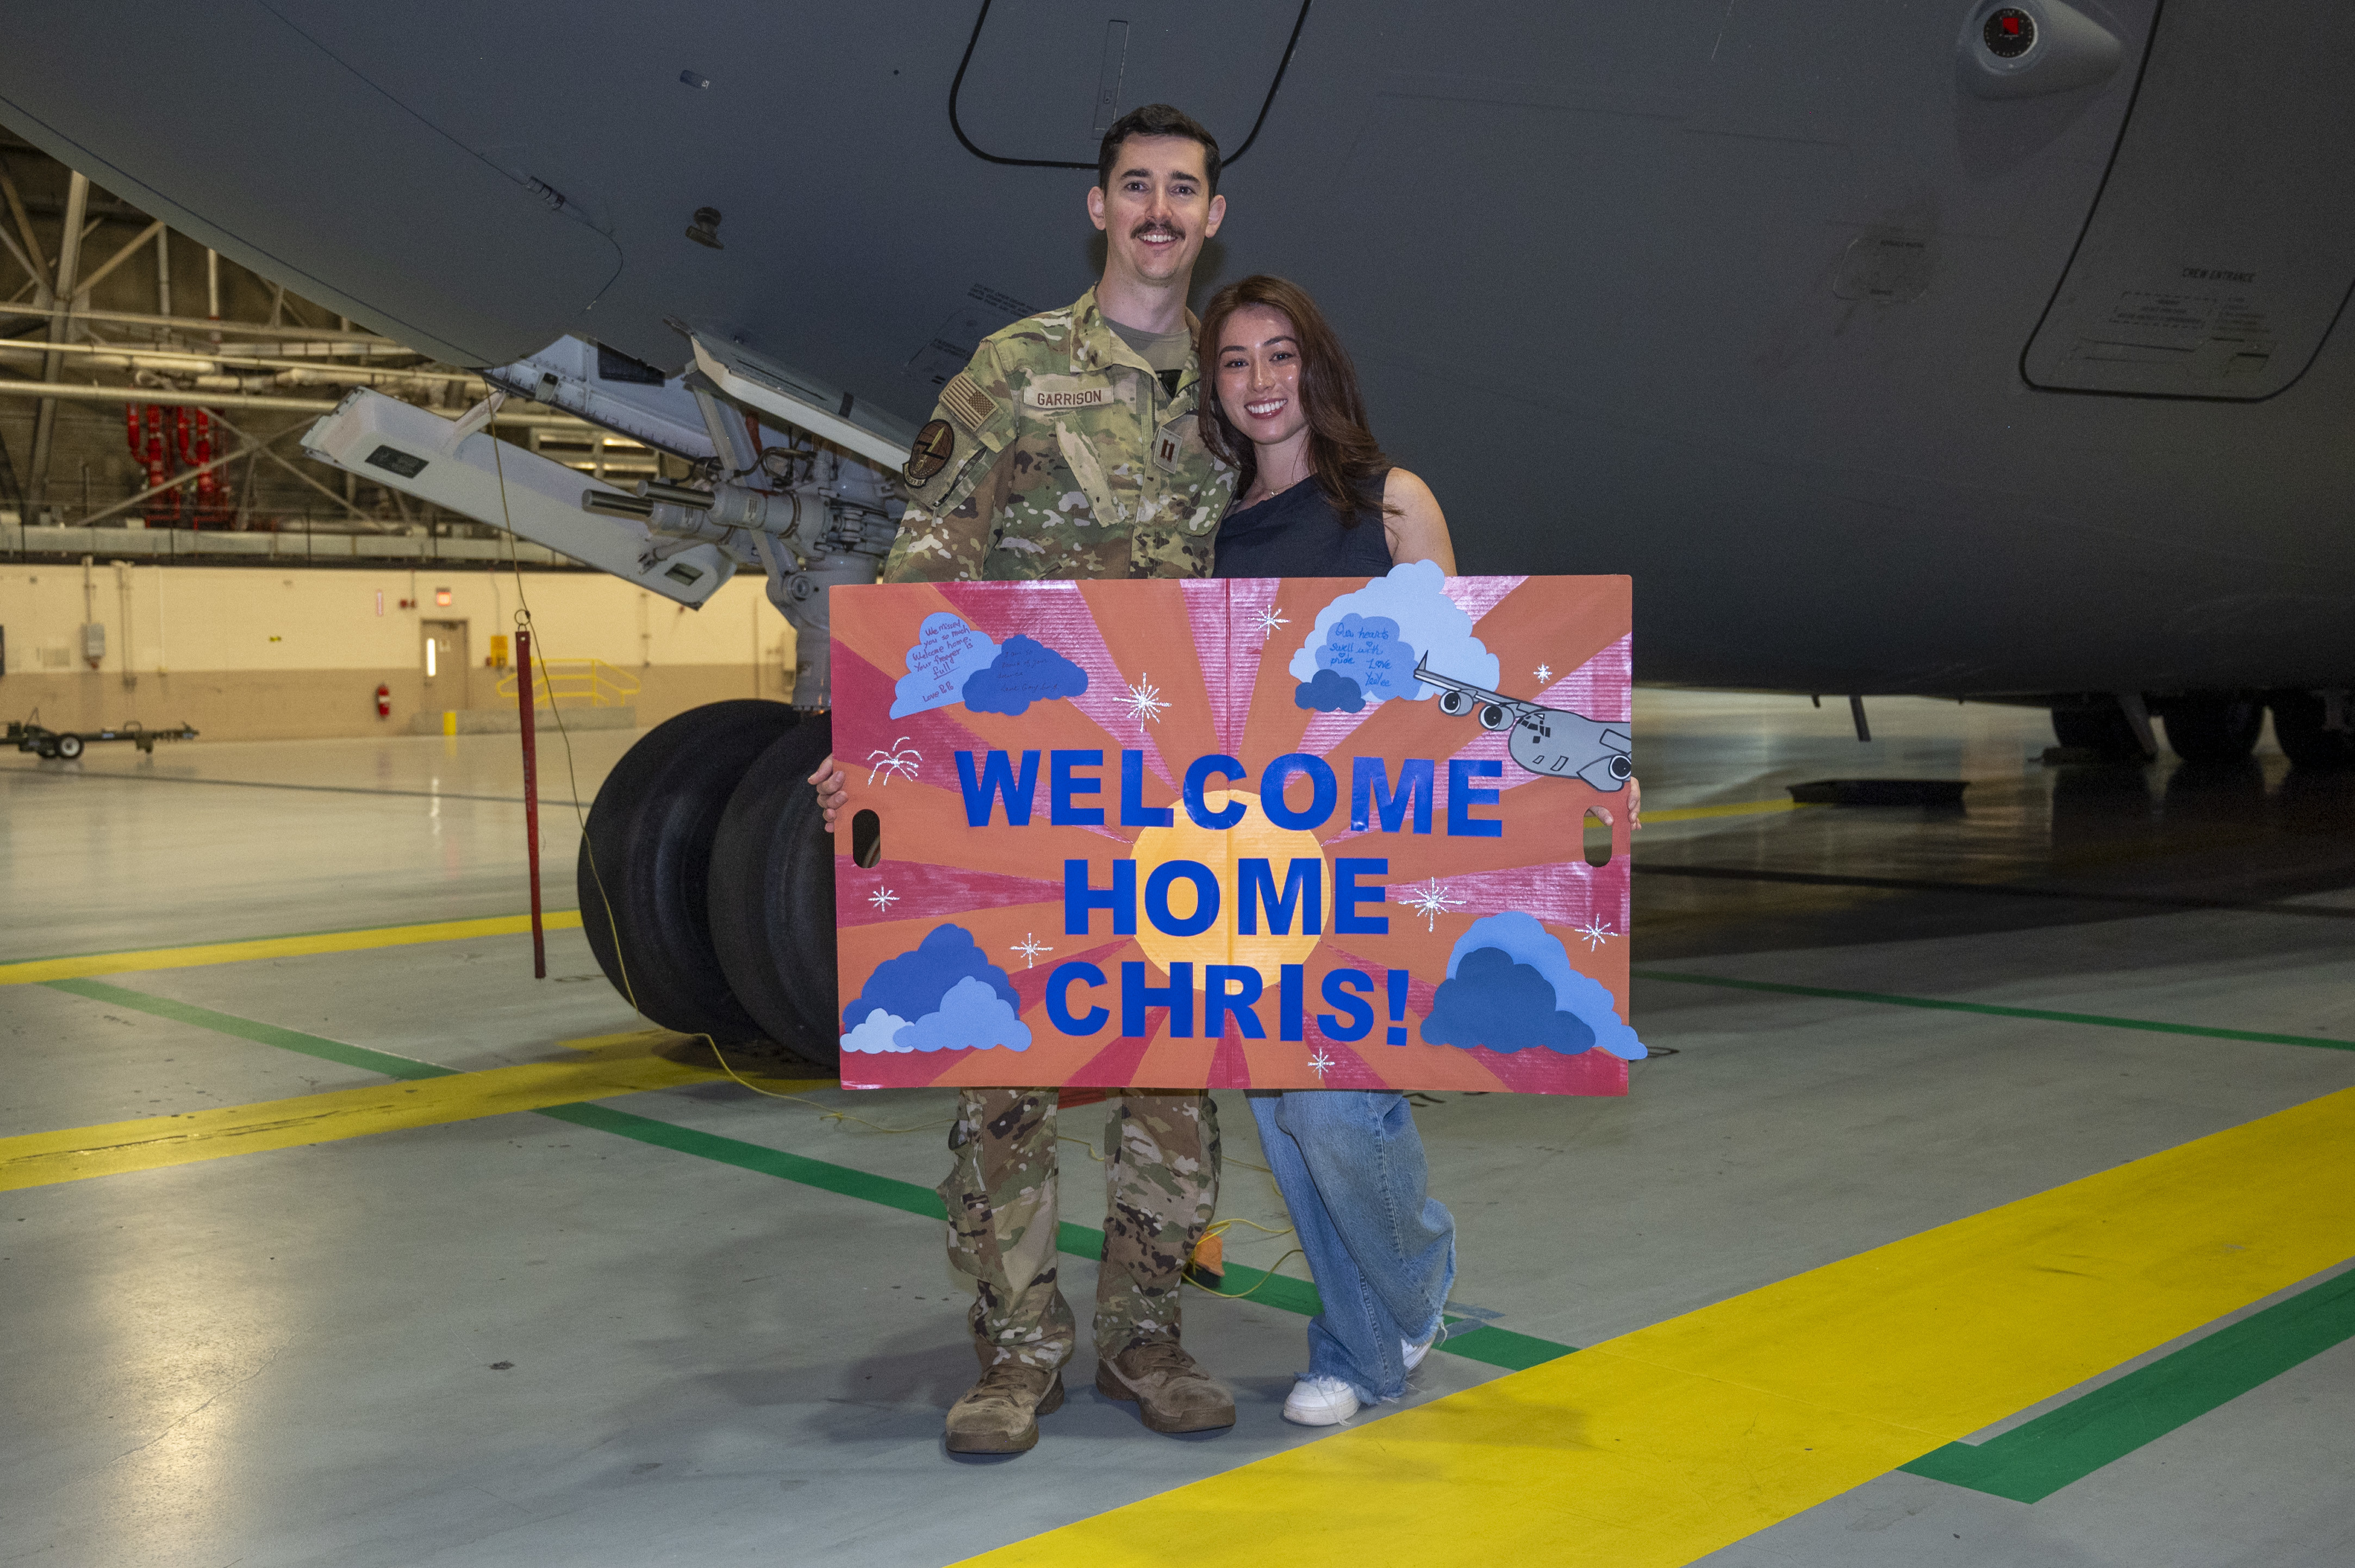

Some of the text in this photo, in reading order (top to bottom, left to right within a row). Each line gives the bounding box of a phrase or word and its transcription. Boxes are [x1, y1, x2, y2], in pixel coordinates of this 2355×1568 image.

[1037, 390, 1102, 406] GARRISON
[925, 619, 961, 636] We missed
[1336, 622, 1389, 640] Our hearts
[924, 638, 938, 649] you
[951, 624, 970, 637] much
[912, 646, 944, 661] Welcome
[1356, 644, 1384, 655] with
[914, 661, 931, 672] Your
[1330, 653, 1355, 666] pride
[933, 661, 951, 678] full
[923, 691, 939, 702] Love
[954, 749, 1502, 838] WELCOME
[1064, 858, 1389, 936] HOME
[1045, 961, 1409, 1046] CHRIS!
